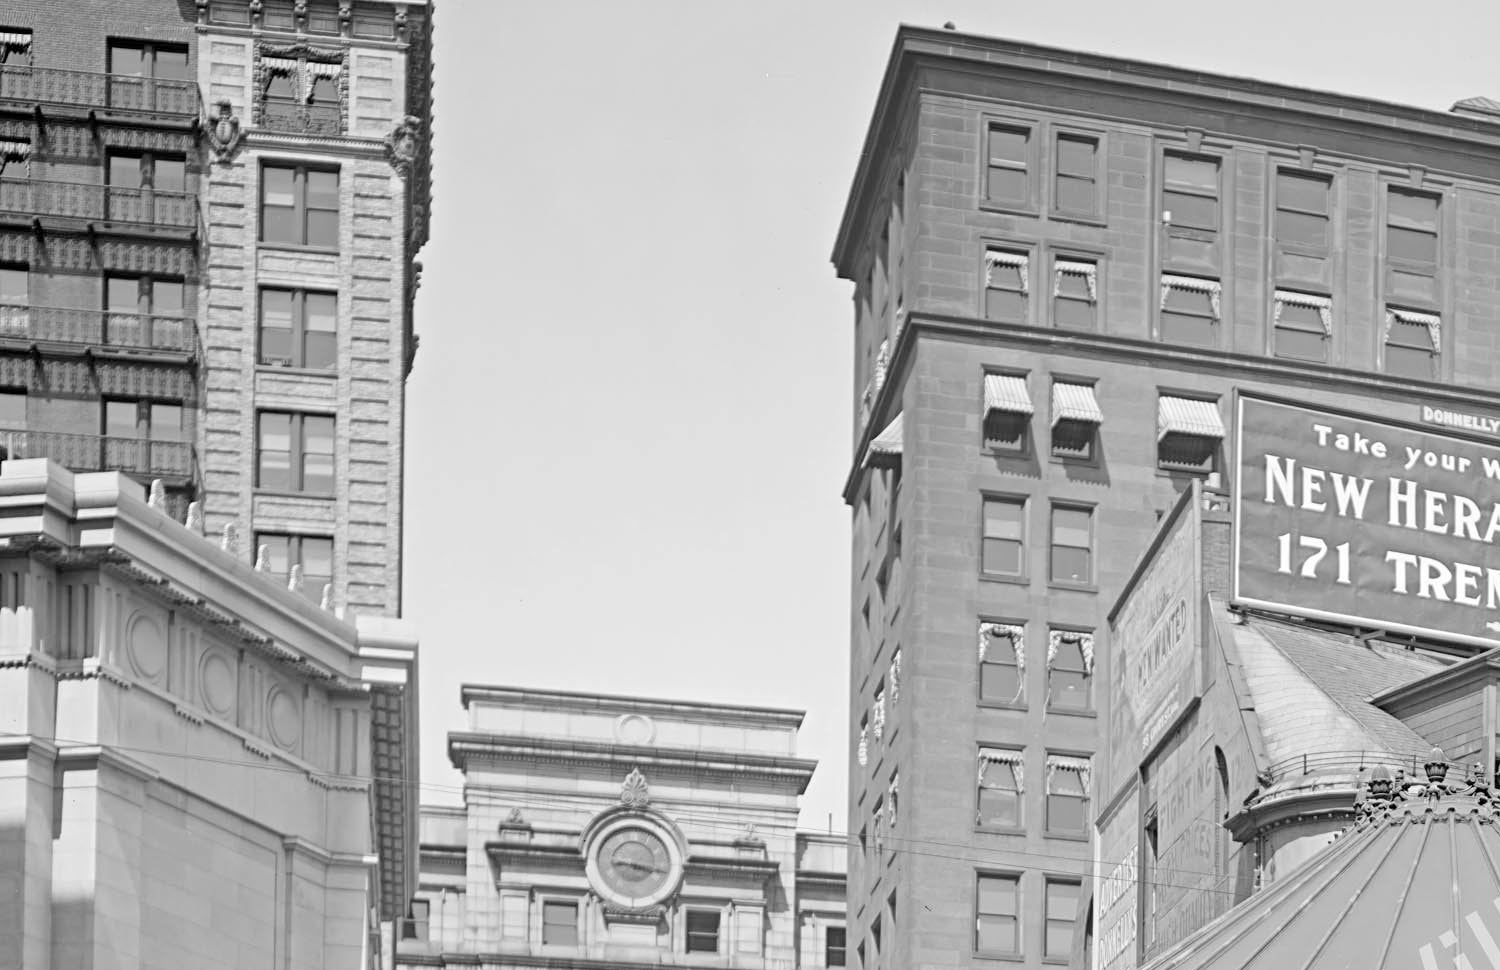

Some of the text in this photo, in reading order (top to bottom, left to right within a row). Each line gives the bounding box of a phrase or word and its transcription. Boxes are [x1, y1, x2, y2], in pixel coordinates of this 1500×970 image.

[1423, 405, 1500, 433] DONNELLY
[1313, 424, 1388, 459] Take
[1404, 443, 1472, 475] your
[1263, 453, 1375, 520] NEW
[1276, 532, 1352, 585] 171
